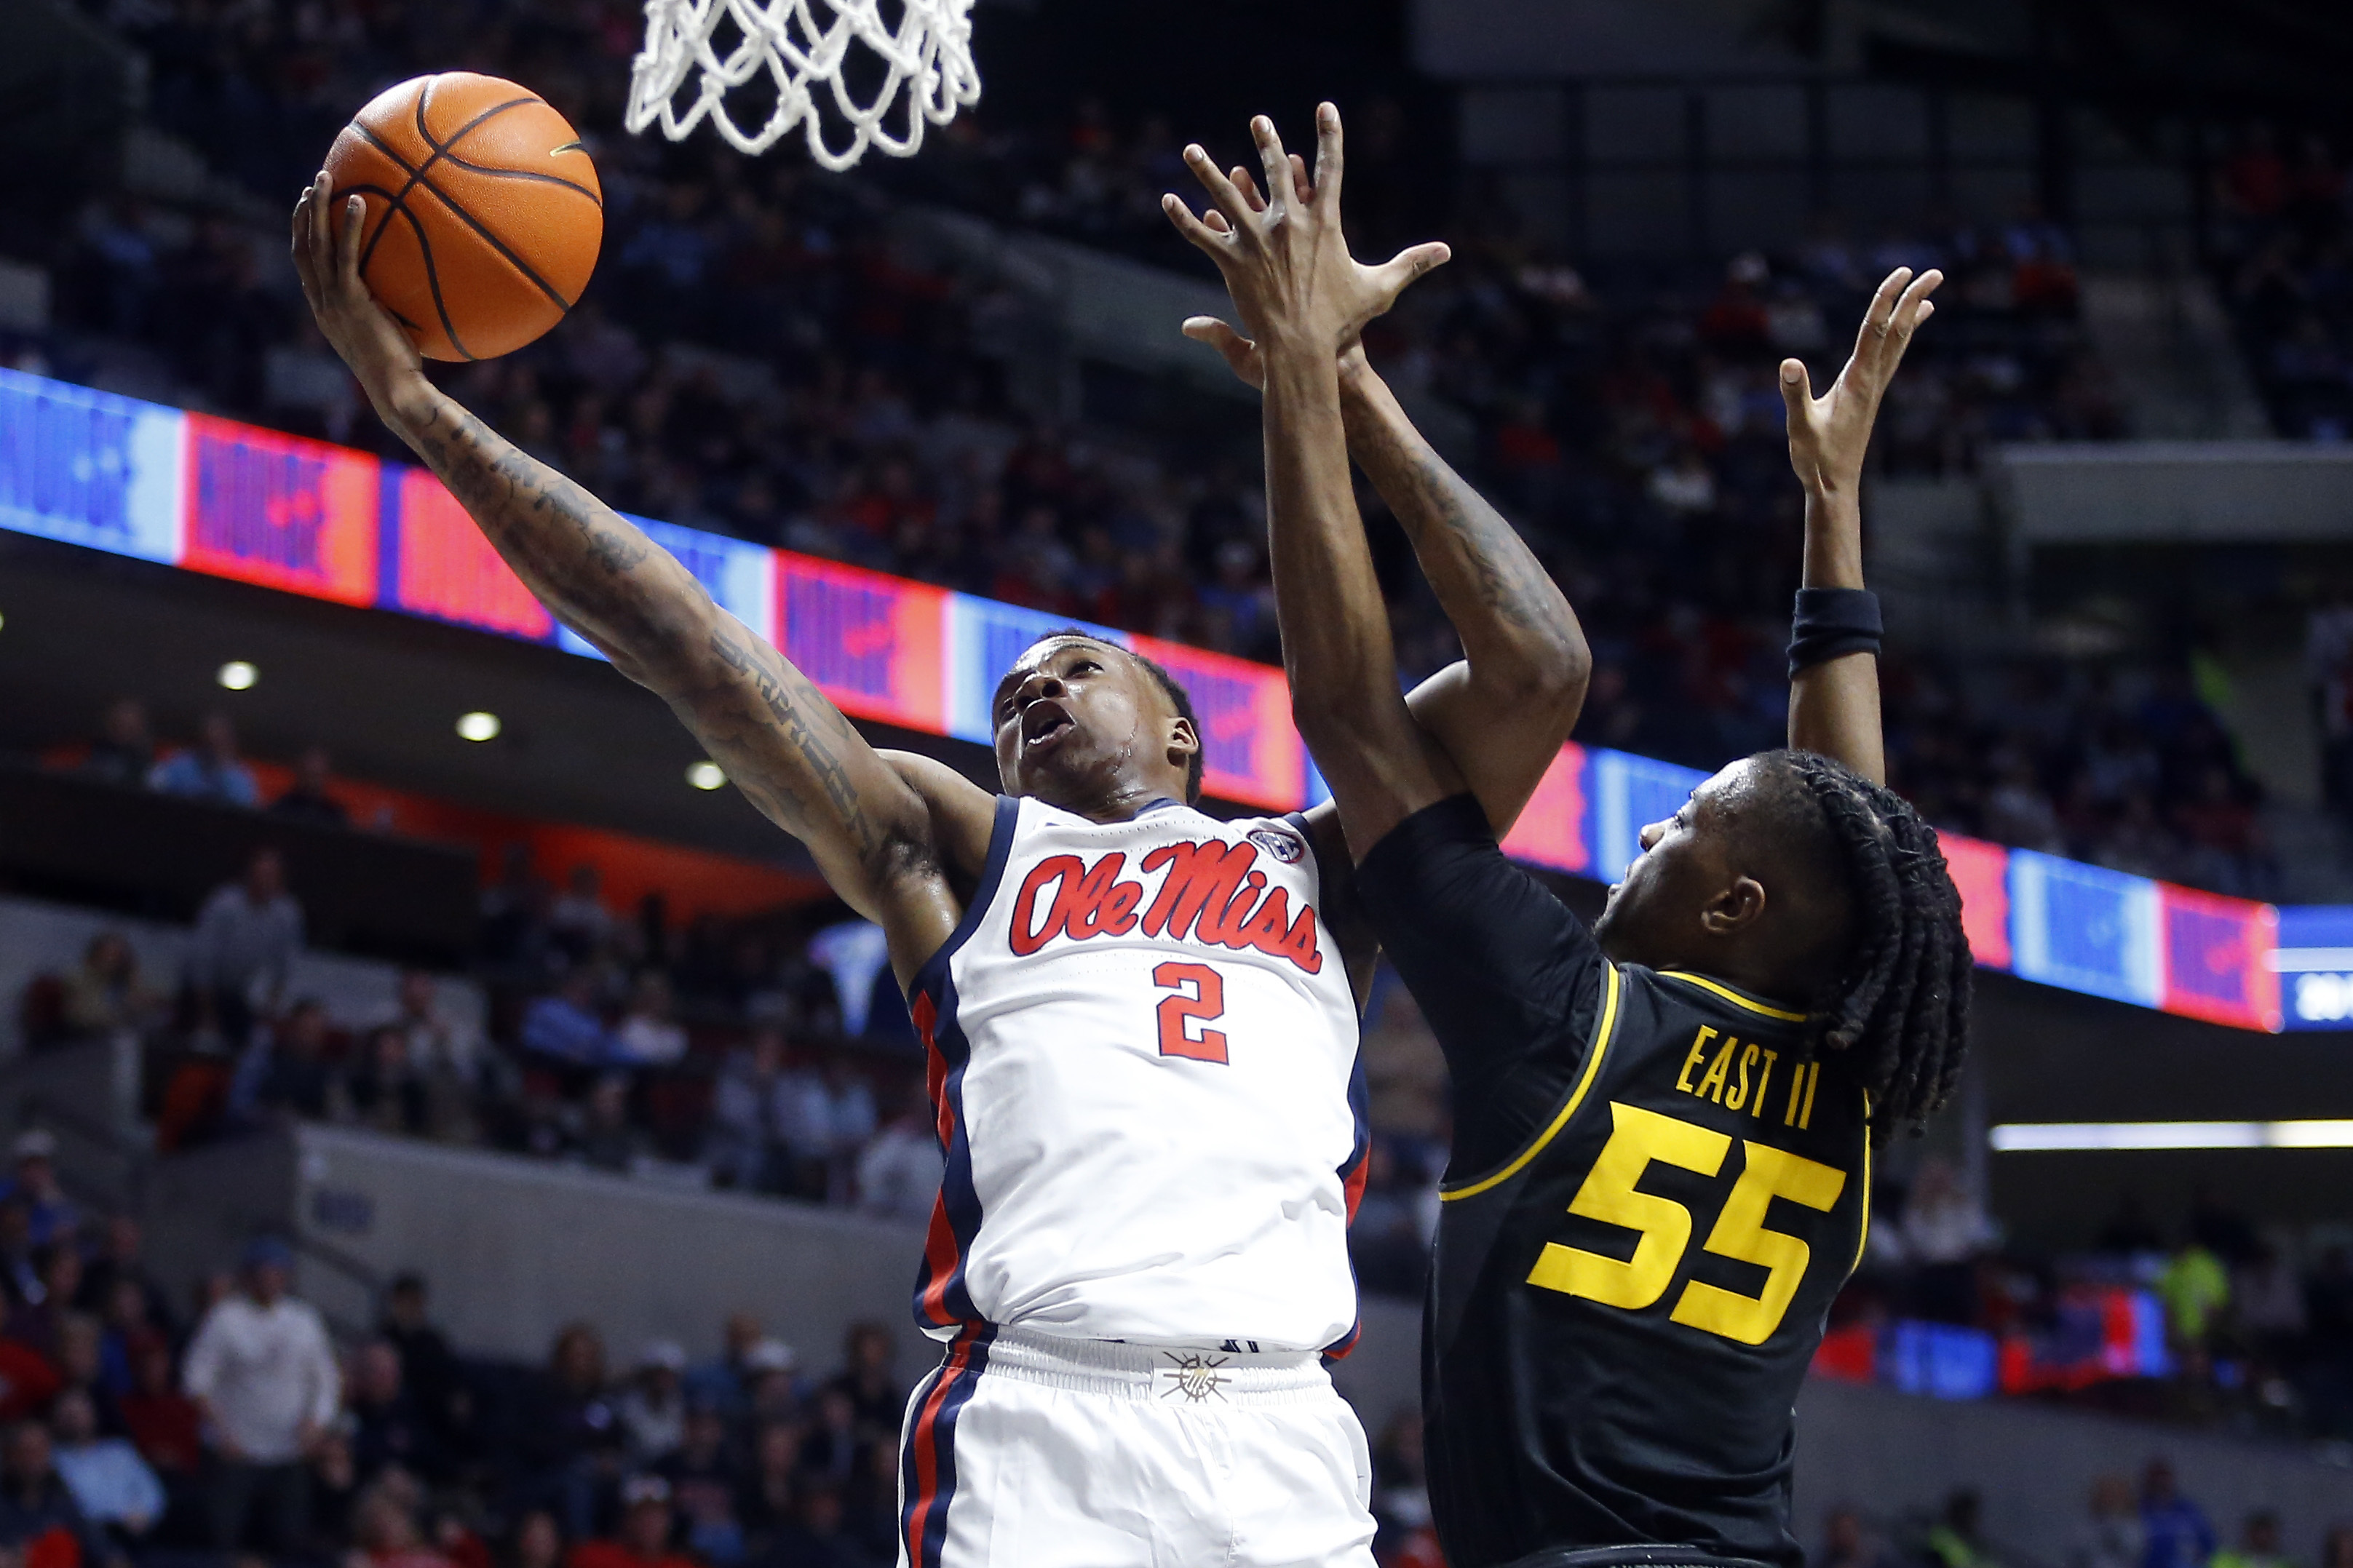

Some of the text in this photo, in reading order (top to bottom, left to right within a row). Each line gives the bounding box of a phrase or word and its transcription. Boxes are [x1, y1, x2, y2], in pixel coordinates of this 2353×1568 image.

[1009, 839, 1323, 974] Ole Miss
[1152, 961, 1230, 1066] 2
[1675, 1024, 1820, 1130] EAST II
[1525, 1100, 1847, 1346] 55
